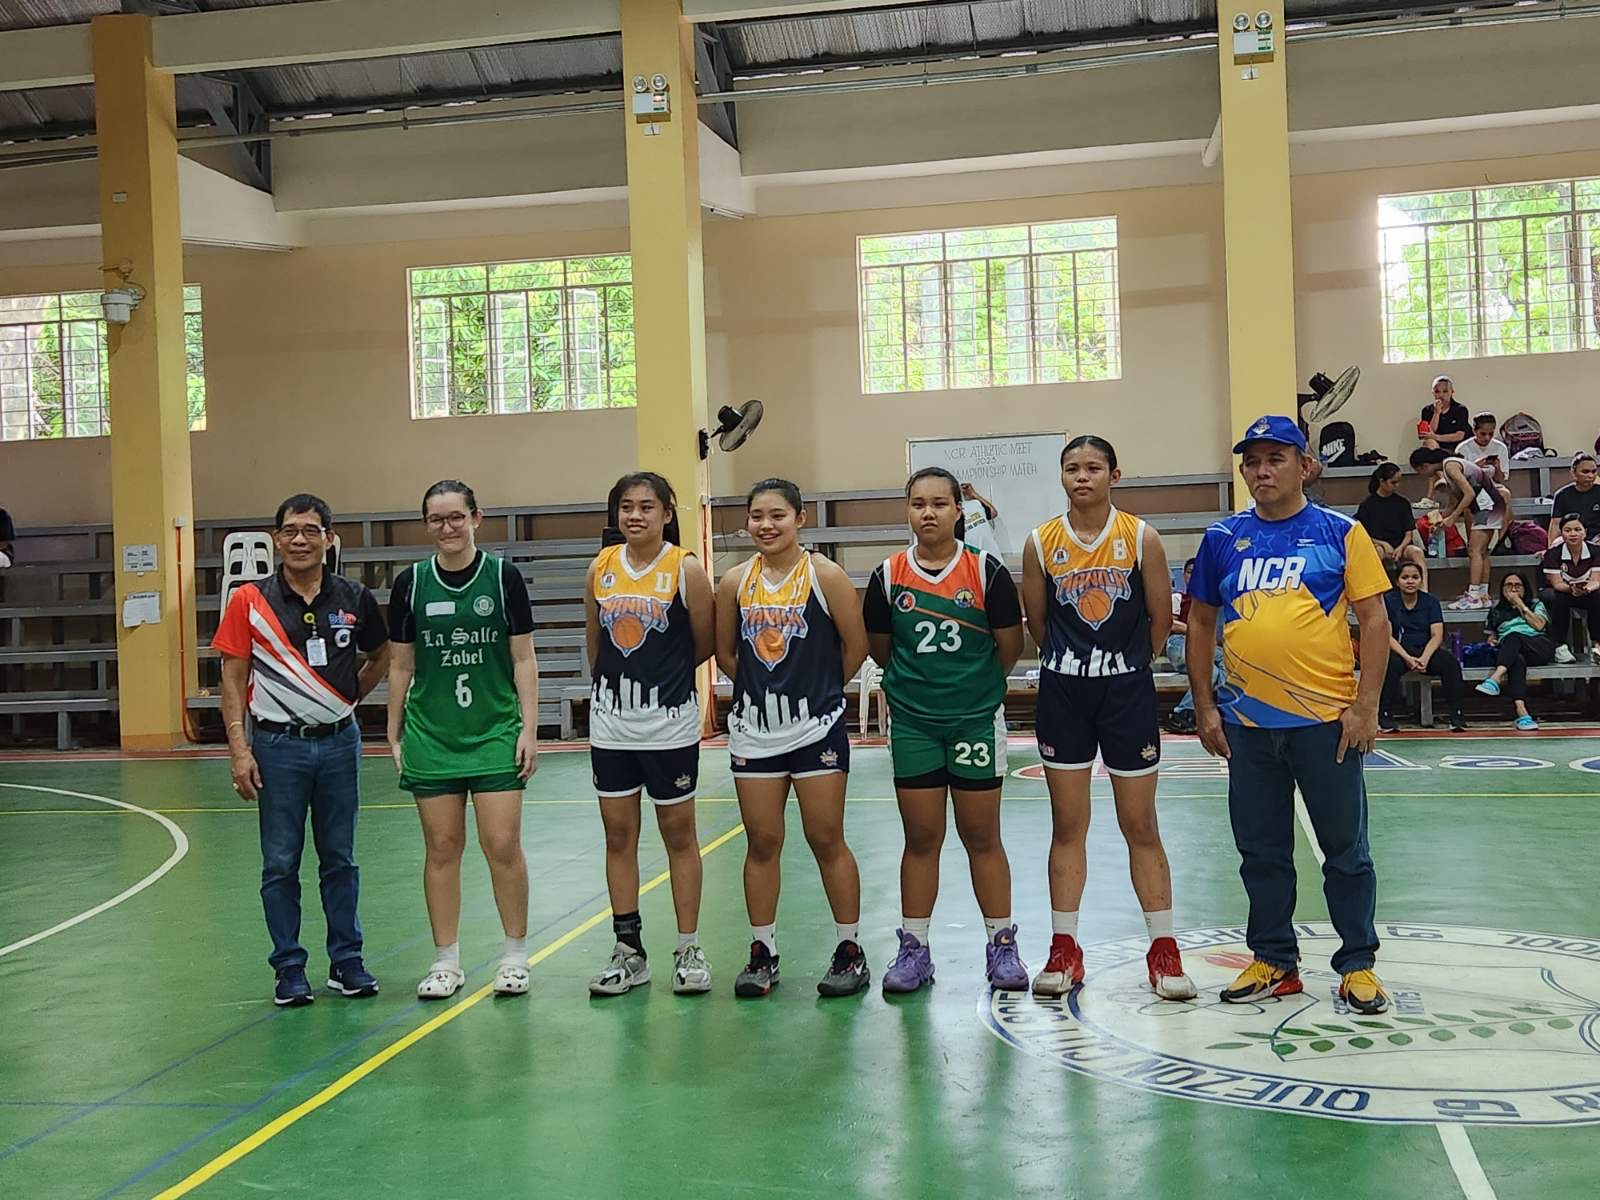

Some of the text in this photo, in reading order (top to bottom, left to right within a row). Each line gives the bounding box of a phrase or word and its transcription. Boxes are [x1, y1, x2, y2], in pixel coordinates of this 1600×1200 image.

[1321, 438, 1345, 457] NIKE
[953, 463, 1007, 481] AMPIONSHIP
[1237, 556, 1306, 591] NCR
[421, 627, 499, 648] La Salle
[914, 619, 962, 654] 23
[440, 649, 484, 668] Zobel
[455, 673, 473, 709] 6
[954, 741, 991, 767] 23
[1104, 1057, 1371, 1112] QUEZON
